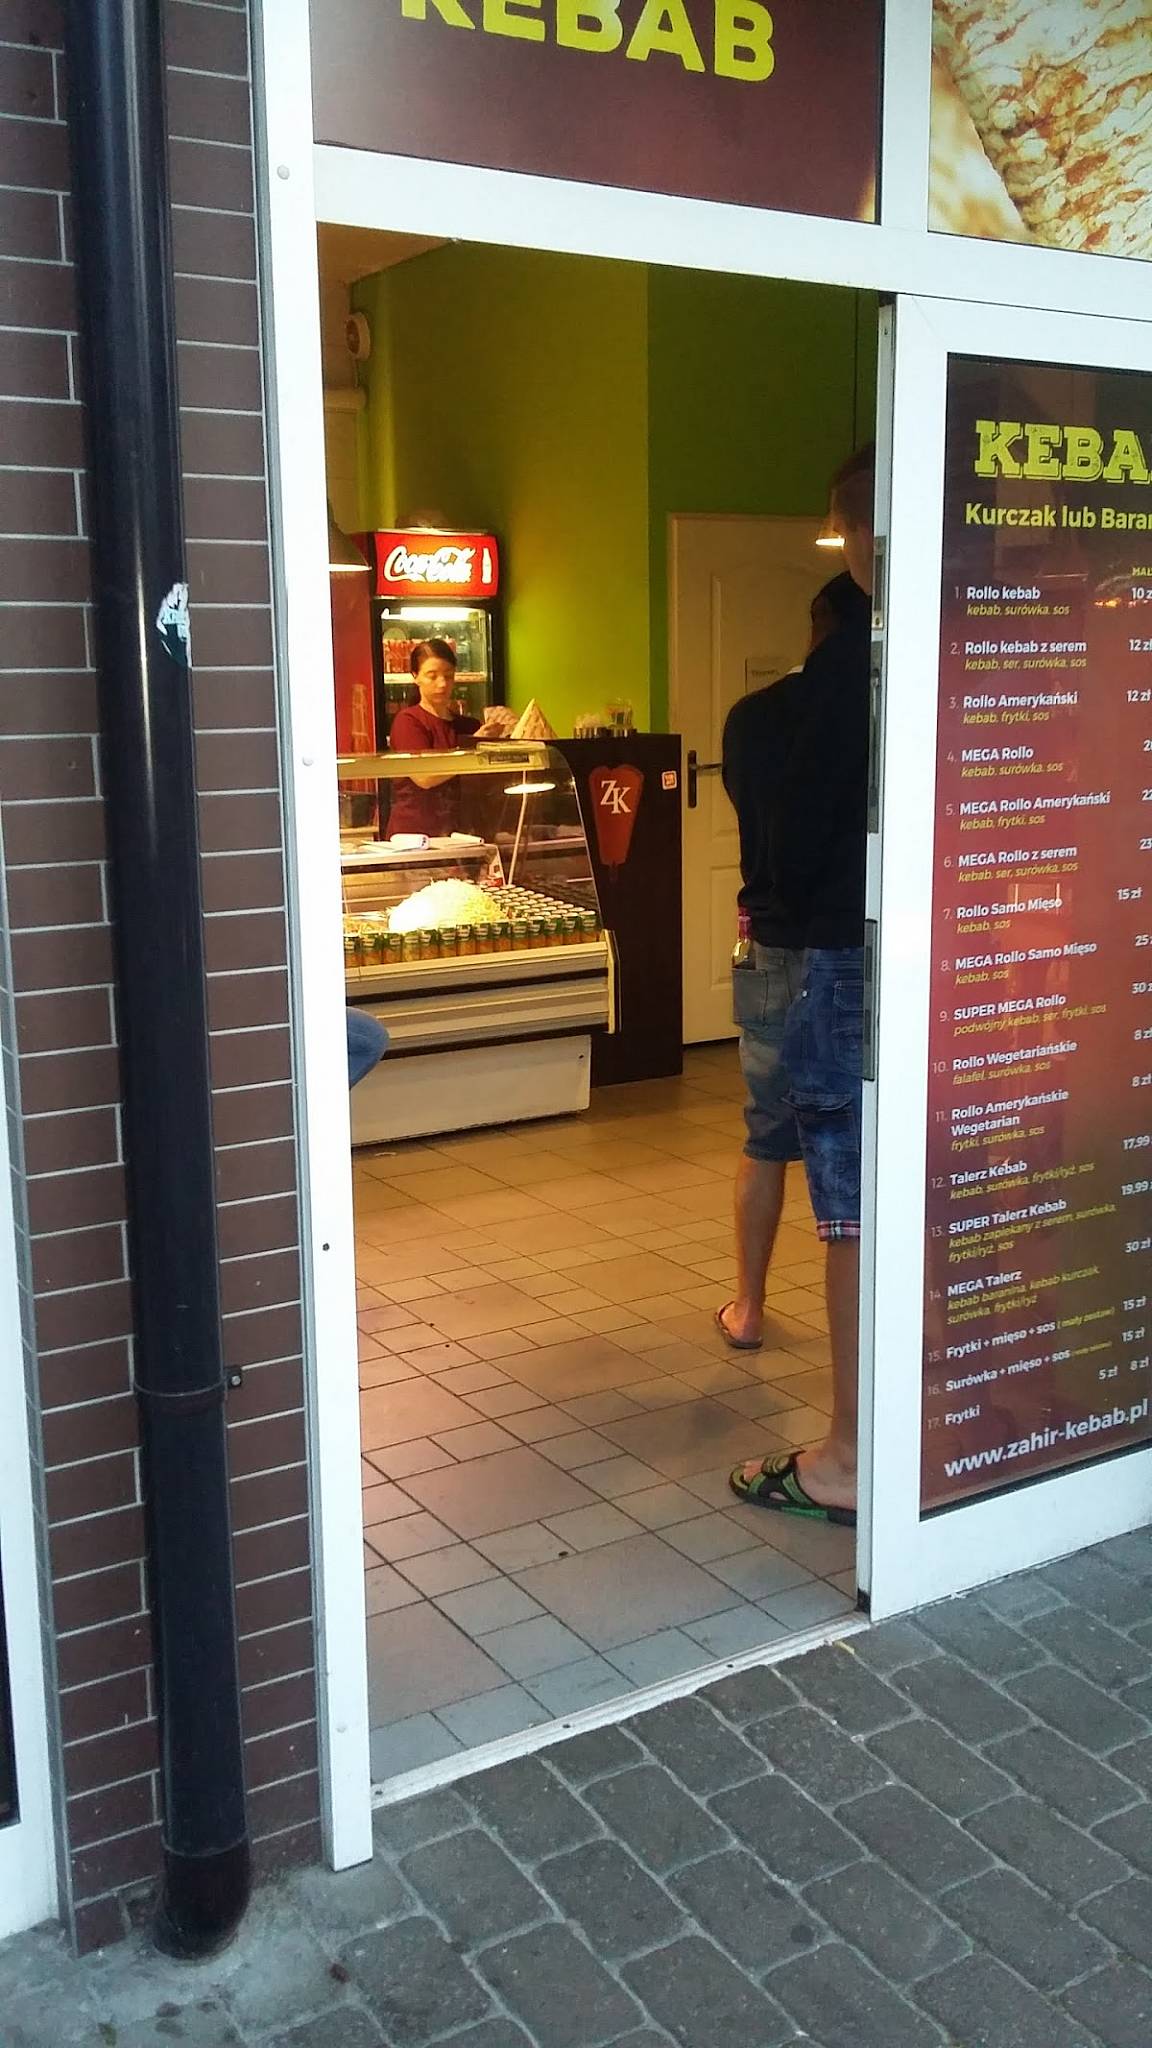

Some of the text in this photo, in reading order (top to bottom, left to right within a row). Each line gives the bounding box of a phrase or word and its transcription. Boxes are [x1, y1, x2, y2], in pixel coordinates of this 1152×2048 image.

[974, 419, 1152, 484] KEBA
[965, 503, 1057, 527] Kurczak
[1062, 504, 1096, 528] lub
[384, 545, 476, 583] Coca-Cola
[967, 587, 1000, 600] Rollo
[1002, 587, 1041, 600] kebab
[1132, 587, 1145, 600] 10
[1053, 605, 1070, 615] sos
[965, 642, 998, 655] Rollo
[1000, 640, 1038, 653] kebab
[1040, 643, 1048, 652] z
[1050, 641, 1087, 652] serem
[1129, 639, 1142, 651] 12
[1070, 658, 1087, 668] sos
[963, 695, 997, 709] Rollo
[998, 691, 1078, 709] Amerykański
[1127, 688, 1152, 702] 12 zł
[1032, 711, 1050, 721] sos
[961, 748, 999, 762] MEGA
[1002, 746, 1034, 760] Rollo
[1047, 762, 1064, 772] sos
[600, 779, 632, 814] ZK
[960, 801, 997, 815] MEGA
[1000, 798, 1032, 812] Rollo
[1033, 790, 1111, 810] Amerykański
[1028, 814, 1046, 825] sos
[958, 853, 996, 868] MEGA
[998, 850, 1029, 863] Rollo
[1031, 850, 1039, 860] z
[1040, 846, 1078, 859] serem
[1062, 862, 1079, 872] sos
[1117, 886, 1142, 901] 15 zł
[957, 905, 989, 919] Rollo
[991, 901, 1026, 916] Samo
[1028, 897, 1063, 912] Mięso
[994, 919, 1011, 930] sos
[1135, 934, 1149, 946] 25
[955, 956, 993, 970] MEGA
[995, 951, 1027, 965] Rollo
[1027, 946, 1062, 961] Samo
[1063, 942, 1097, 956] Mięso
[992, 970, 1010, 980] sos
[1132, 982, 1147, 994] 30
[953, 1003, 996, 1021] SUPER
[997, 999, 1034, 1014] MEGA
[1035, 994, 1066, 1009] Rollo
[1134, 1029, 1142, 1041] 8
[952, 1055, 985, 1071] Rollo
[986, 1040, 1078, 1068] Wegetariańskie
[1034, 1061, 1051, 1072] sos
[1132, 1076, 1140, 1087] 8
[951, 1105, 983, 1121] Rollo
[984, 1089, 1069, 1116] Amerykańskie
[951, 1115, 1021, 1138] Wegetarian
[1028, 1125, 1046, 1137] sos
[1123, 1135, 1150, 1150] 17,99
[949, 1169, 988, 1187] Talerz
[988, 1159, 1028, 1177] Kebab
[1121, 1180, 1149, 1196] 19,99
[948, 1215, 990, 1235] SUPER
[992, 1208, 1028, 1225] Talerz
[1029, 1199, 1067, 1216] Kebab
[949, 1233, 981, 1249] kebab
[998, 1240, 1016, 1252] sos
[1141, 1237, 1151, 1249] zł
[947, 1270, 1023, 1297] MEGA Talerz
[947, 1294, 980, 1311] kebab
[1123, 1295, 1147, 1311] 15 zł
[946, 1338, 982, 1360] Frytki
[983, 1340, 990, 1348] +
[991, 1329, 1027, 1347] mięso
[1028, 1328, 1036, 1336] +
[1036, 1321, 1057, 1335] sos
[1122, 1326, 1145, 1342] 15 zł
[945, 1350, 1071, 1392] Surówka + mięso + sos
[1130, 1356, 1150, 1371] 8 zł
[1098, 1365, 1118, 1380] 5 zł
[944, 1404, 980, 1426] Frytki
[943, 1398, 1149, 1477] www.zahir-kebab.pl
